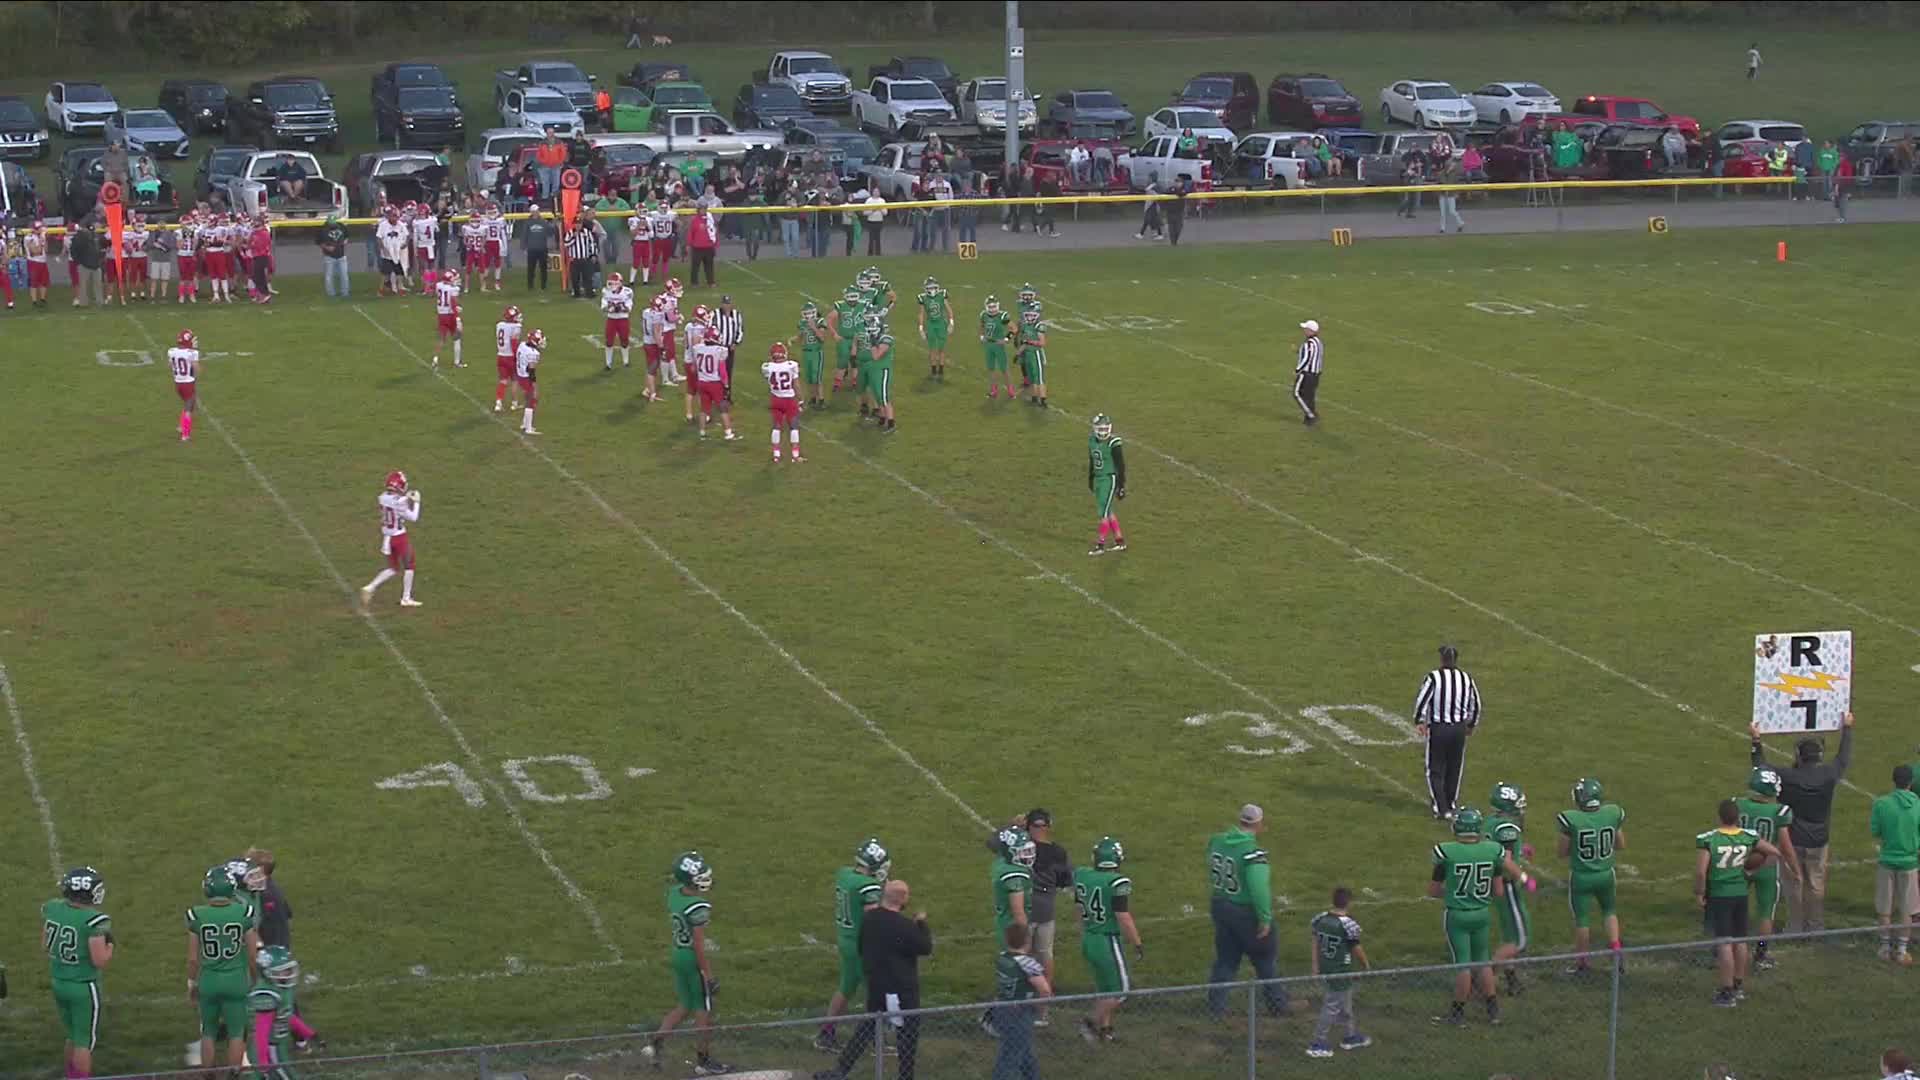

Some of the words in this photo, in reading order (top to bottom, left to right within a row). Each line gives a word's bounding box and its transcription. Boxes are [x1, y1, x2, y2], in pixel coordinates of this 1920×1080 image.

[656, 221, 673, 235] 50
[1652, 217, 1664, 231] G
[960, 244, 976, 258] 20
[697, 353, 714, 374] 70
[769, 371, 791, 391] 42
[1791, 636, 1823, 667] R
[1578, 825, 1616, 863] 50
[1716, 845, 1747, 869] 72
[71, 876, 93, 891] 56
[1454, 862, 1495, 899] 75
[45, 919, 80, 965] 72
[200, 922, 243, 960] 63
